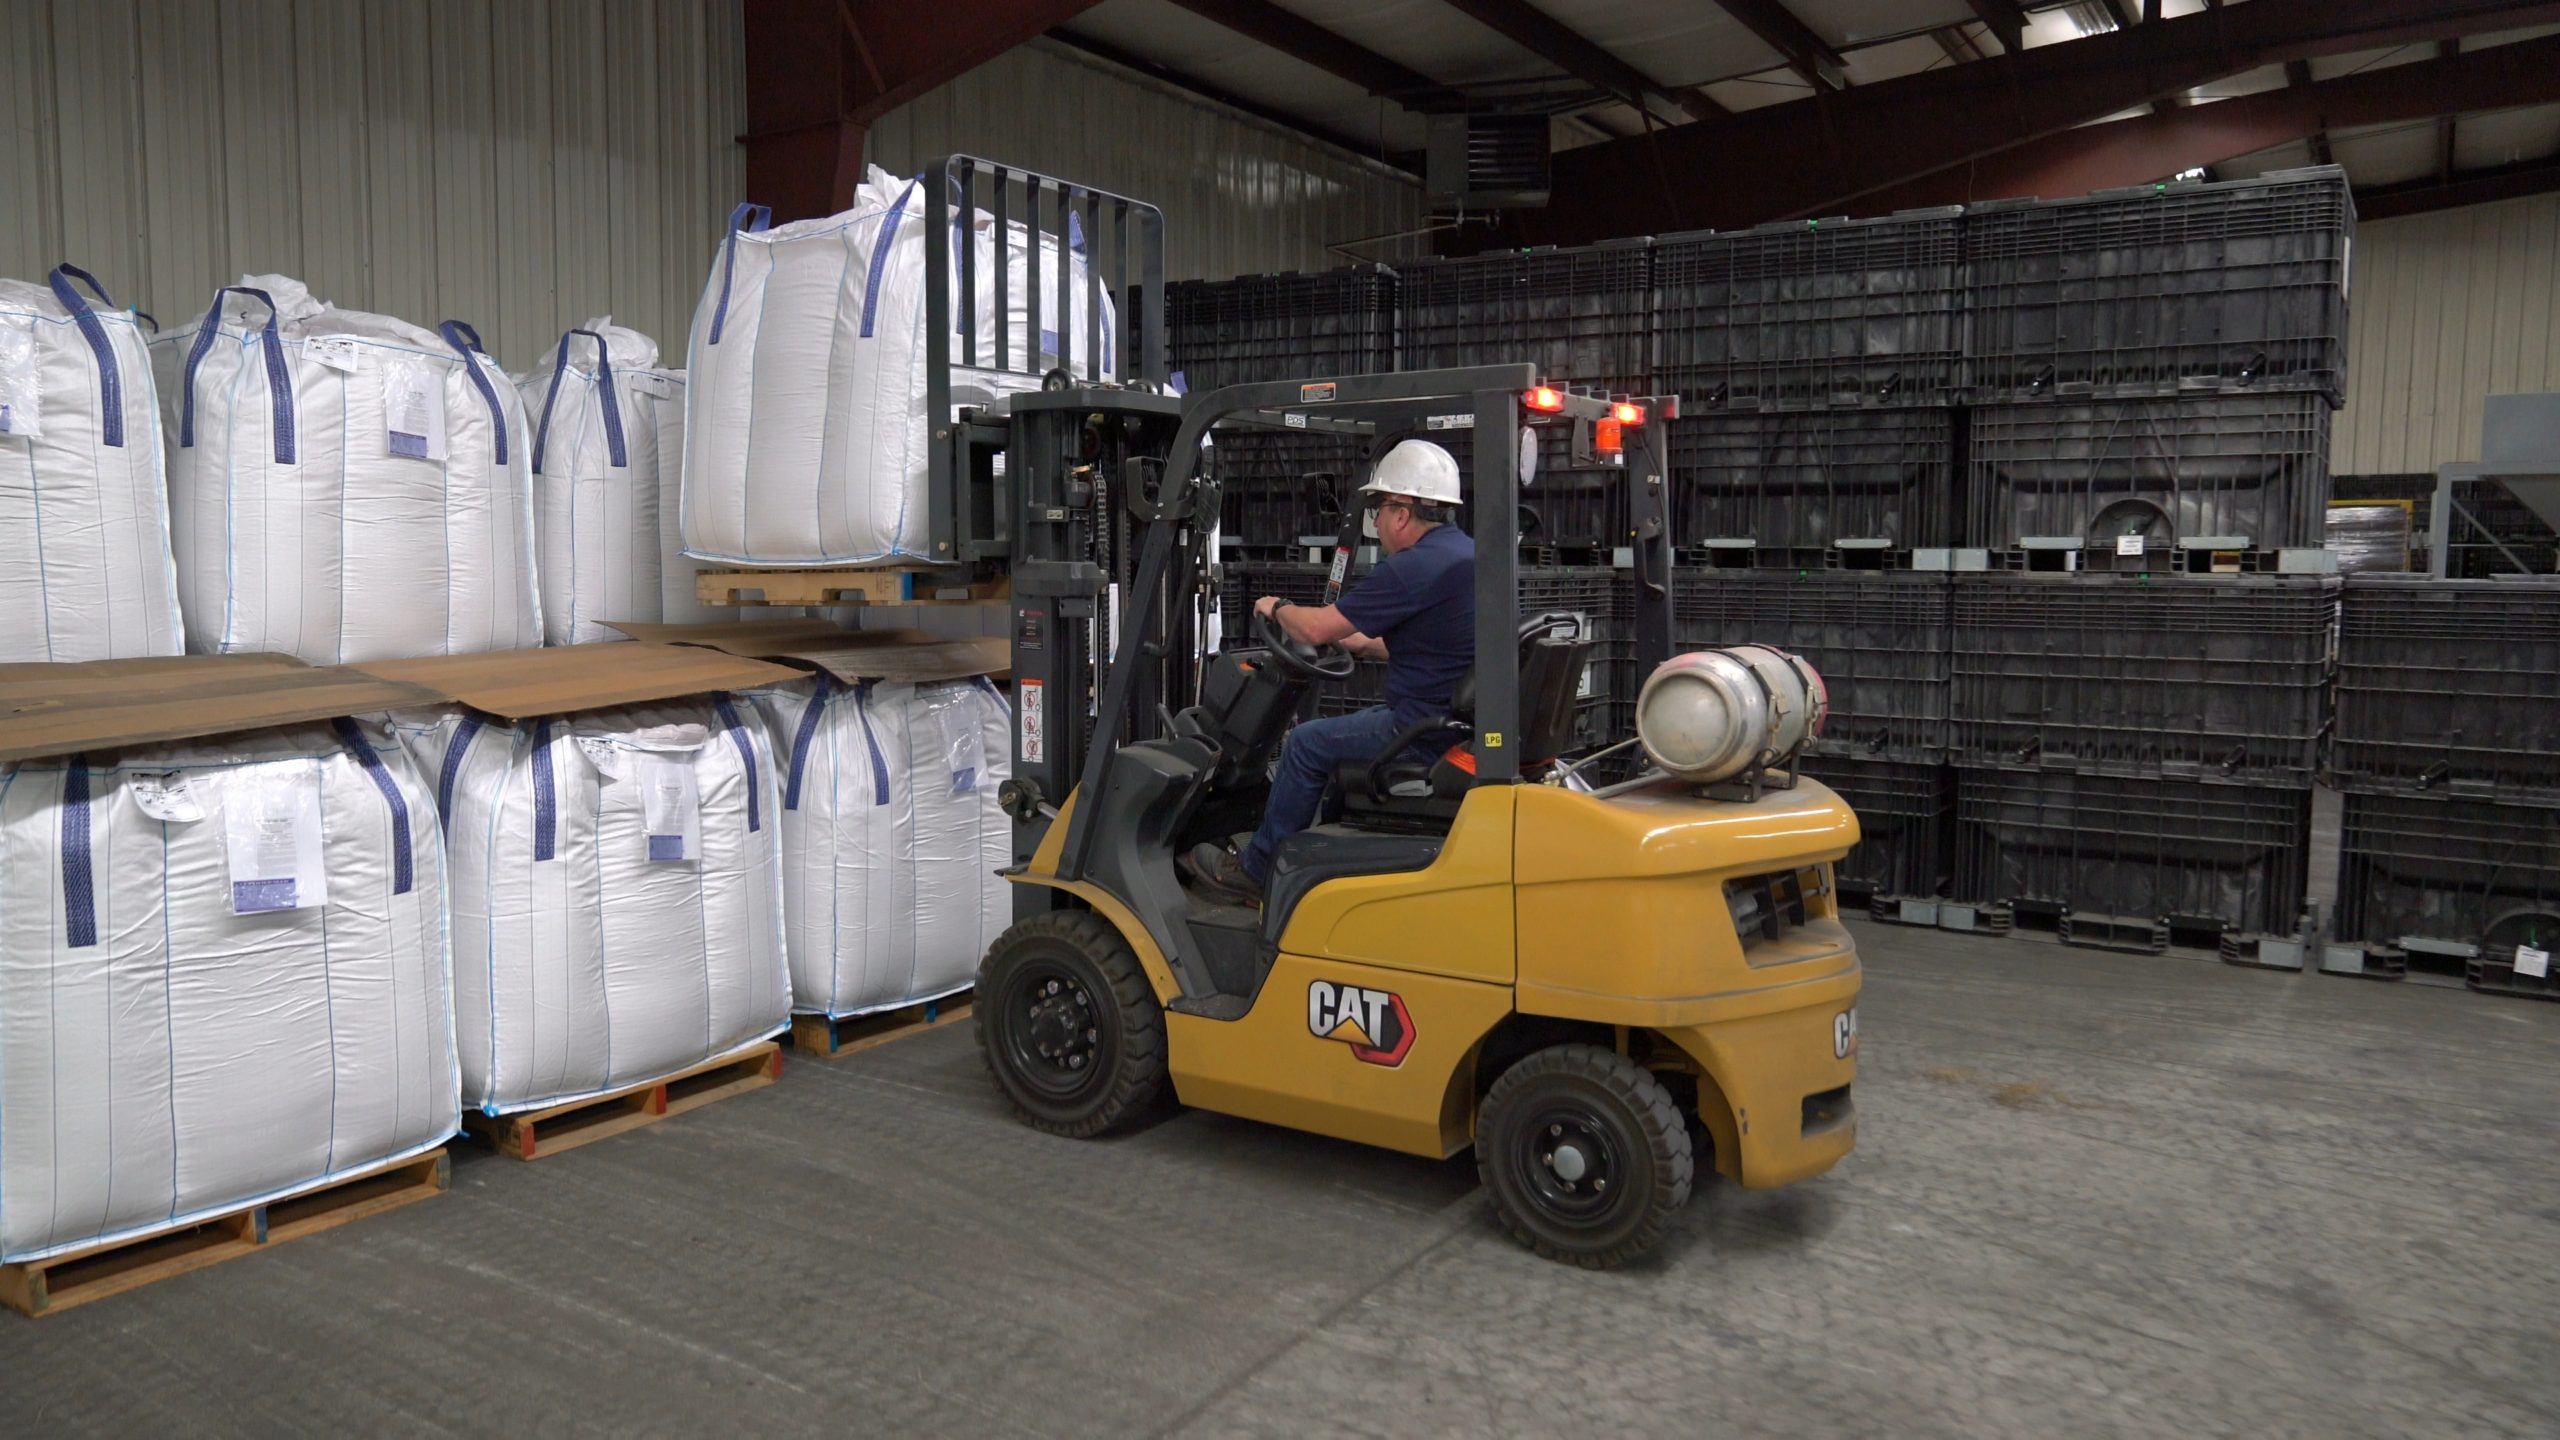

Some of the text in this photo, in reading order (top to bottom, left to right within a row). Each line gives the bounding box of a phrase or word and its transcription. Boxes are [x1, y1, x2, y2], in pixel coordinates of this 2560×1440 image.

[1486, 736, 1501, 744] LPG
[1309, 981, 1389, 1047] CAT
[1834, 1008, 1856, 1057] CA
